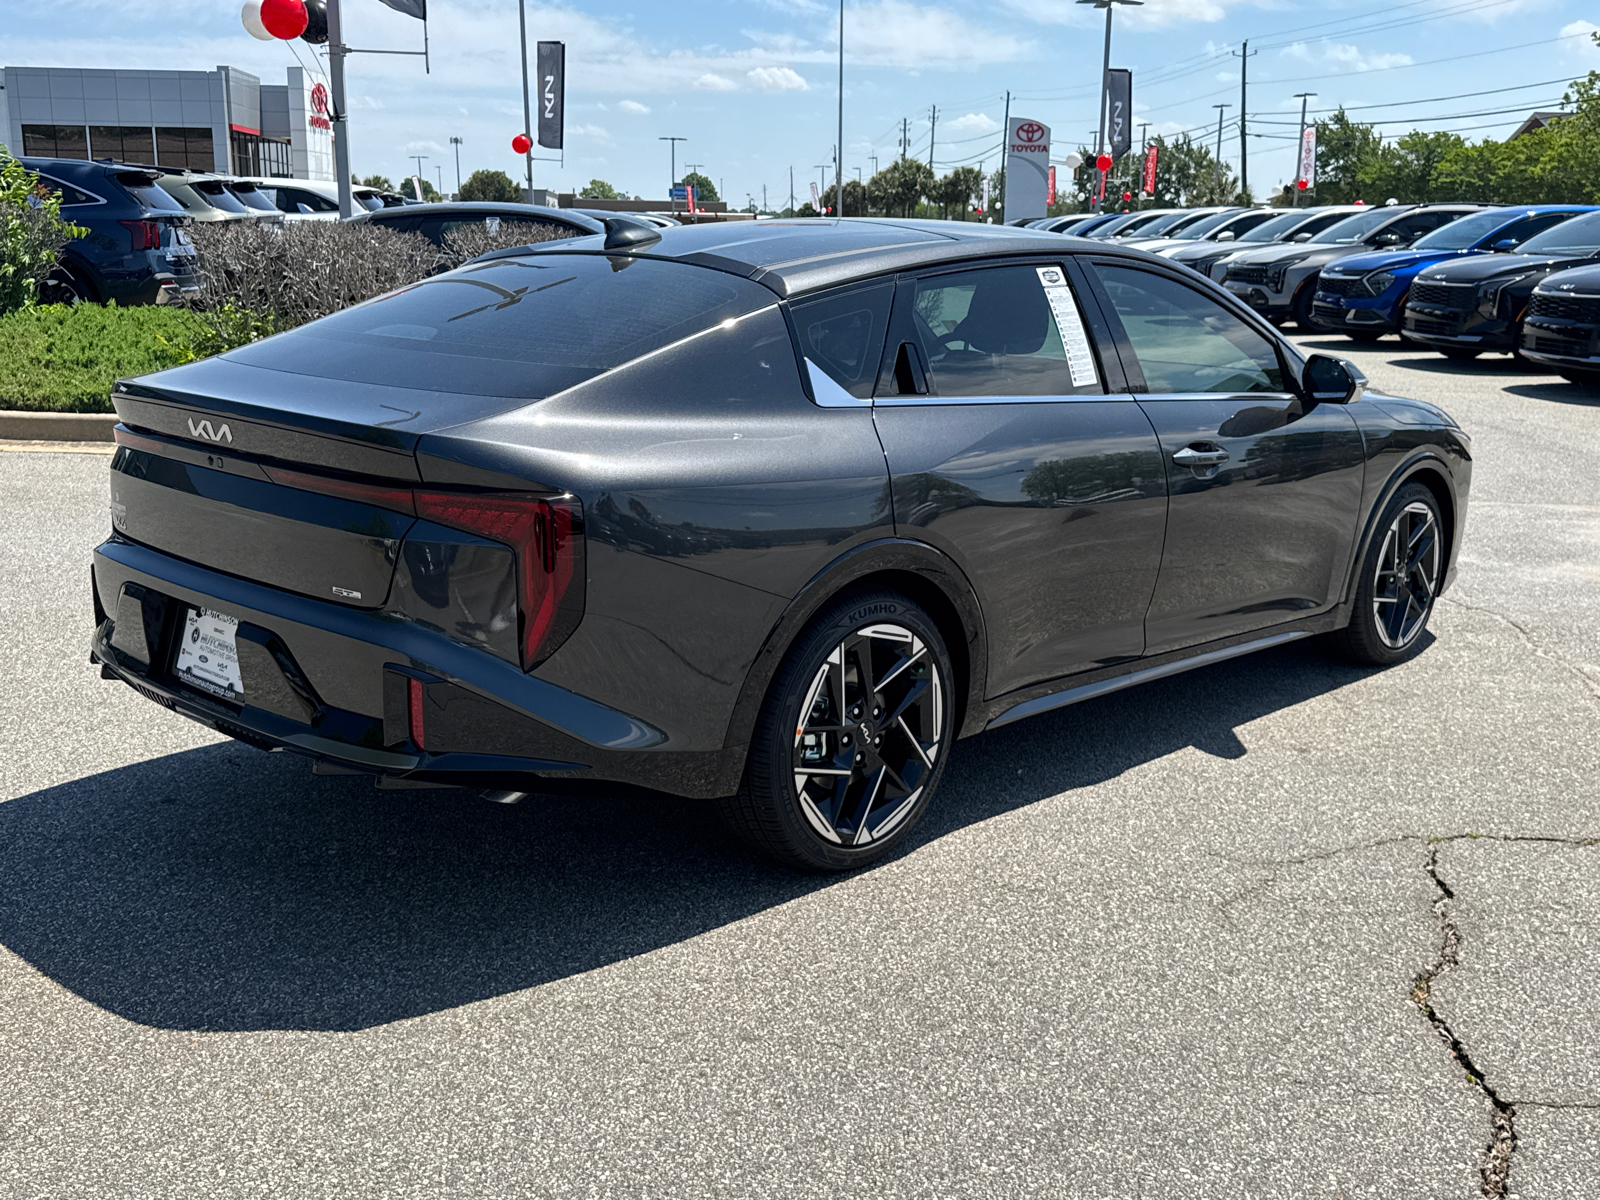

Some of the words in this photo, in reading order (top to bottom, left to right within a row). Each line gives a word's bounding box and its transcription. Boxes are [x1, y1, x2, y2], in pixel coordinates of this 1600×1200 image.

[1011, 145, 1048, 153] TOYOTA
[1302, 141, 1312, 180] TOYOT
[187, 417, 233, 444] KIA
[848, 604, 898, 624] KUMHO
[200, 635, 237, 656] HUTCHINSO
